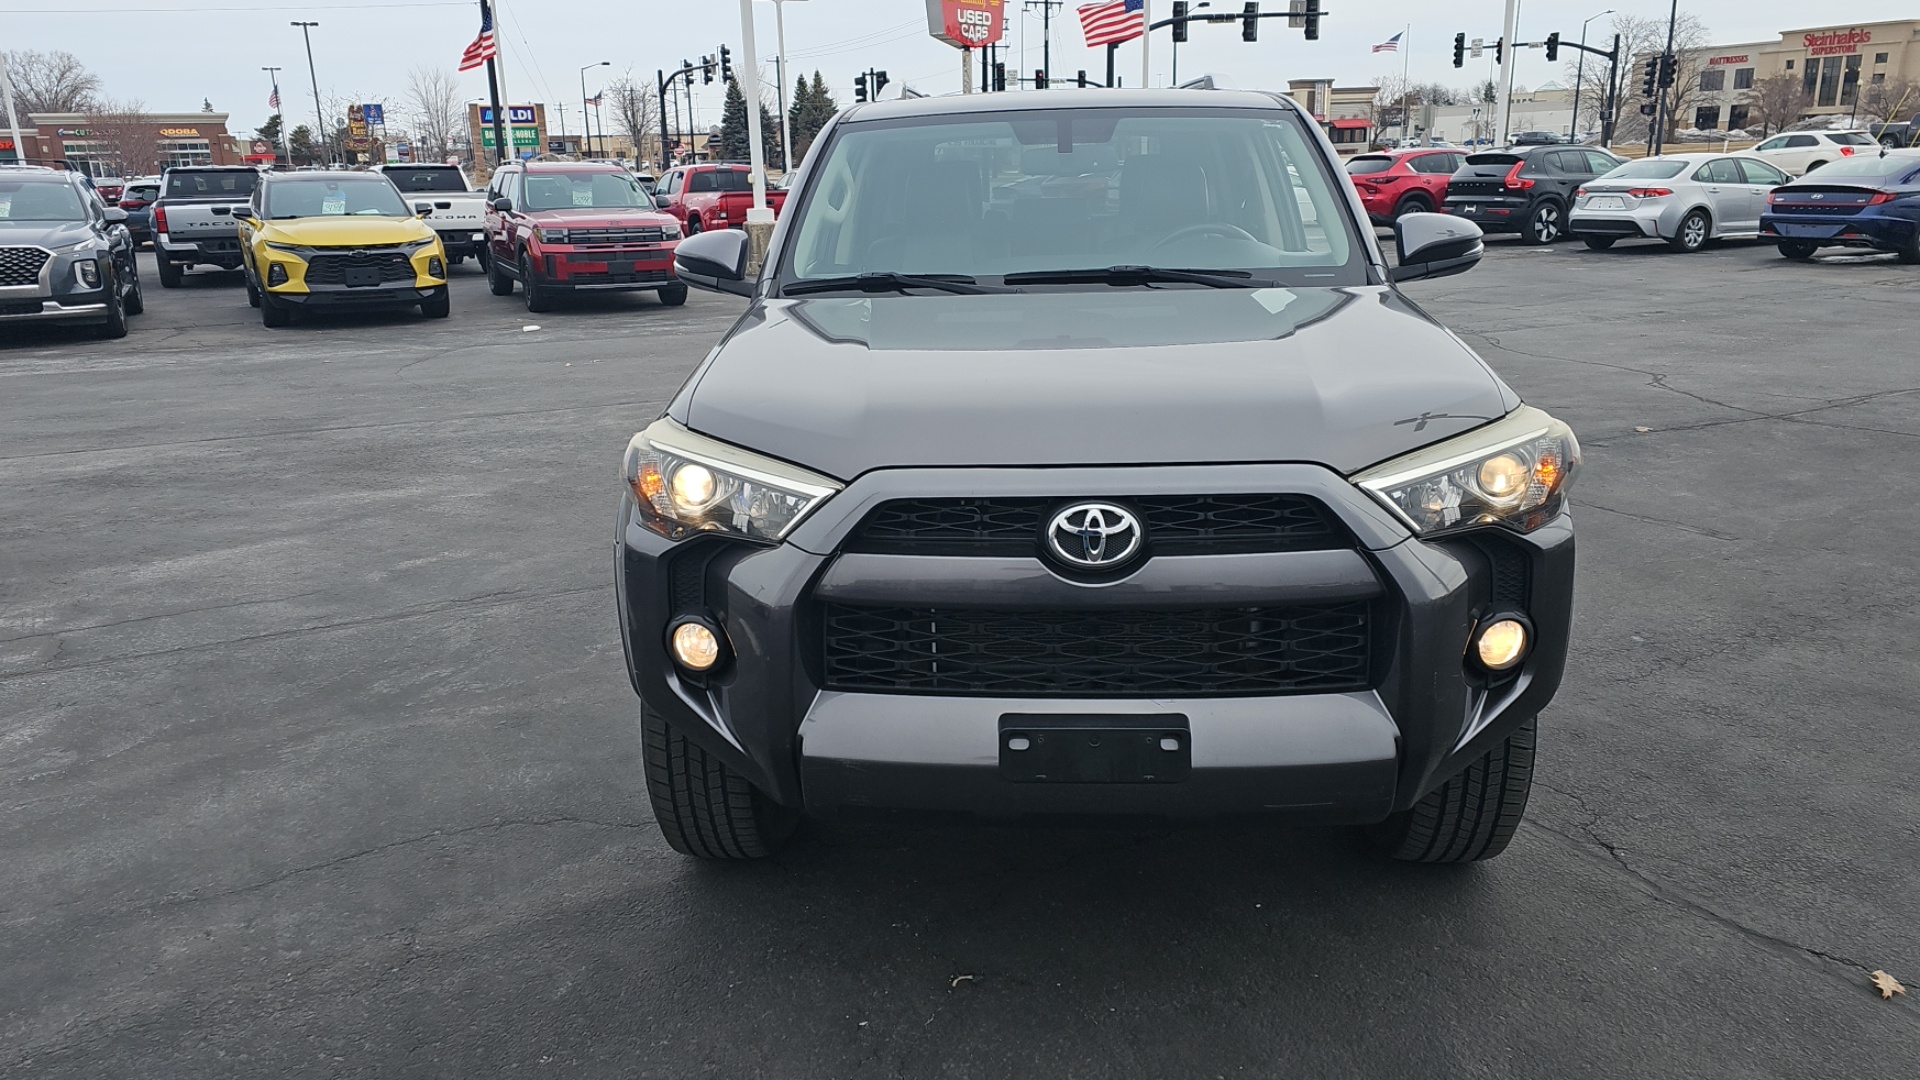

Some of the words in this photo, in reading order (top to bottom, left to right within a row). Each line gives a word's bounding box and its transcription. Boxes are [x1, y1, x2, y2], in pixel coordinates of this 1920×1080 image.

[957, 8, 992, 26] USED
[961, 23, 989, 42] CARS
[1803, 28, 1871, 47] Steinhafels
[1811, 44, 1858, 56] SUPERSTORE
[1709, 55, 1749, 65] MATTRESSES
